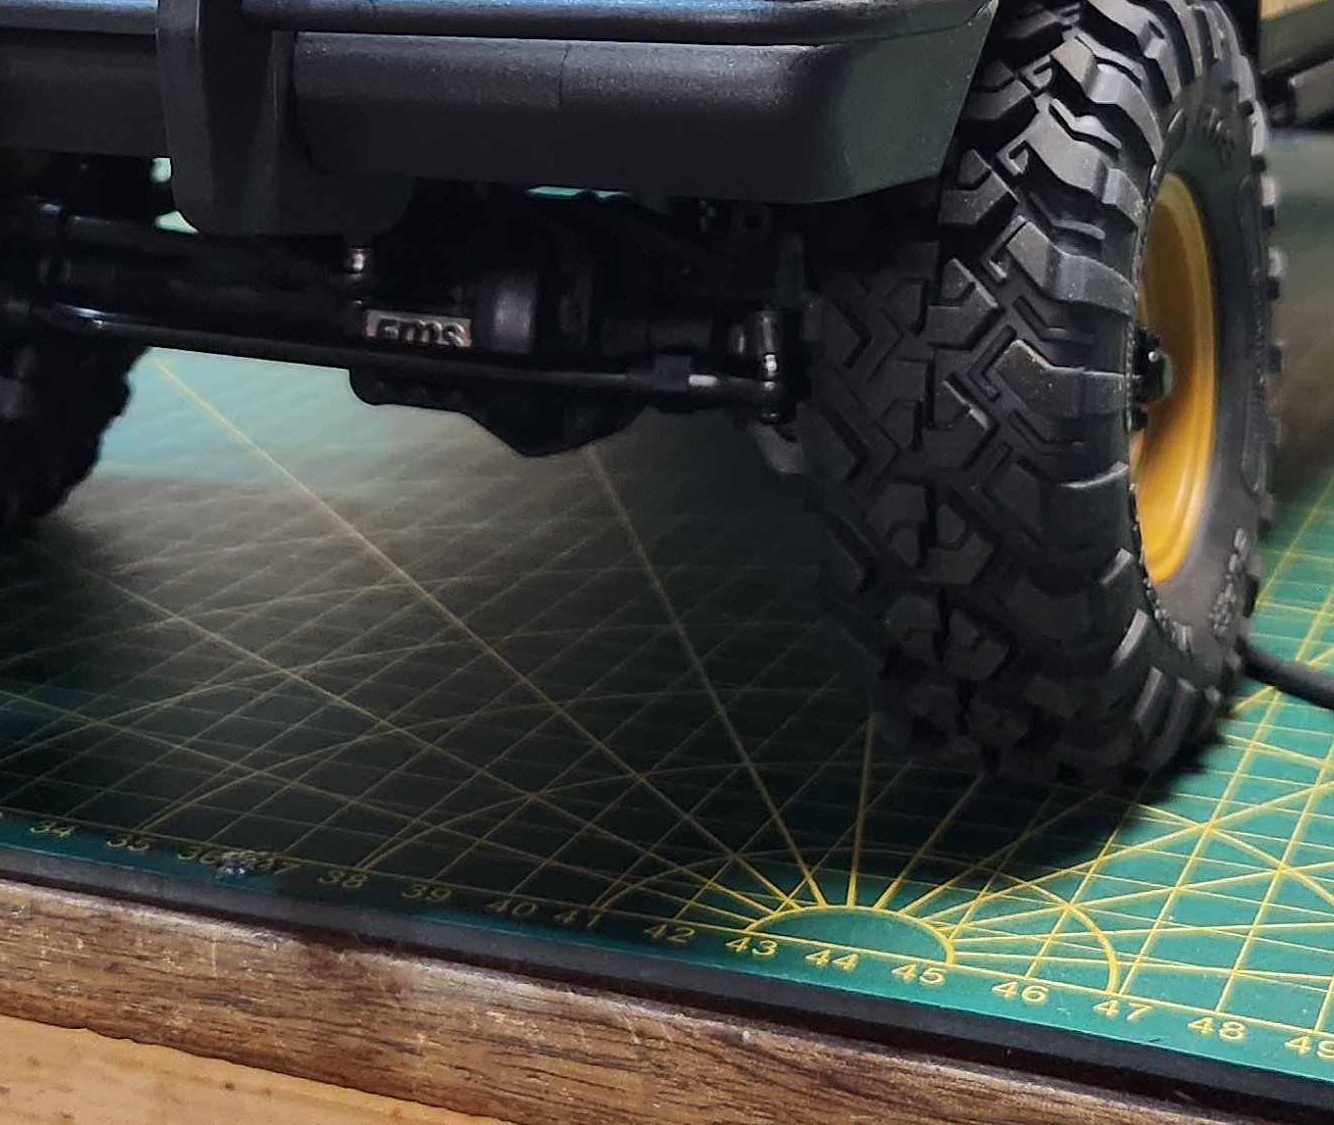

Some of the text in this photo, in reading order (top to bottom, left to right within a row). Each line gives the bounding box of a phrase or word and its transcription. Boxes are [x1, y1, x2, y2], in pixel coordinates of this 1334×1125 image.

[29, 820, 76, 839] 34
[106, 834, 151, 853] 35
[318, 870, 368, 889] 38
[401, 884, 453, 903] 39
[488, 897, 539, 917] 40
[555, 909, 605, 928] 41
[643, 923, 696, 944] 42
[725, 936, 779, 958] 43
[805, 948, 860, 972] 44
[891, 963, 949, 986] 45
[991, 980, 1051, 1004] 46
[1092, 997, 1154, 1022] 47
[1186, 1015, 1247, 1041] 48
